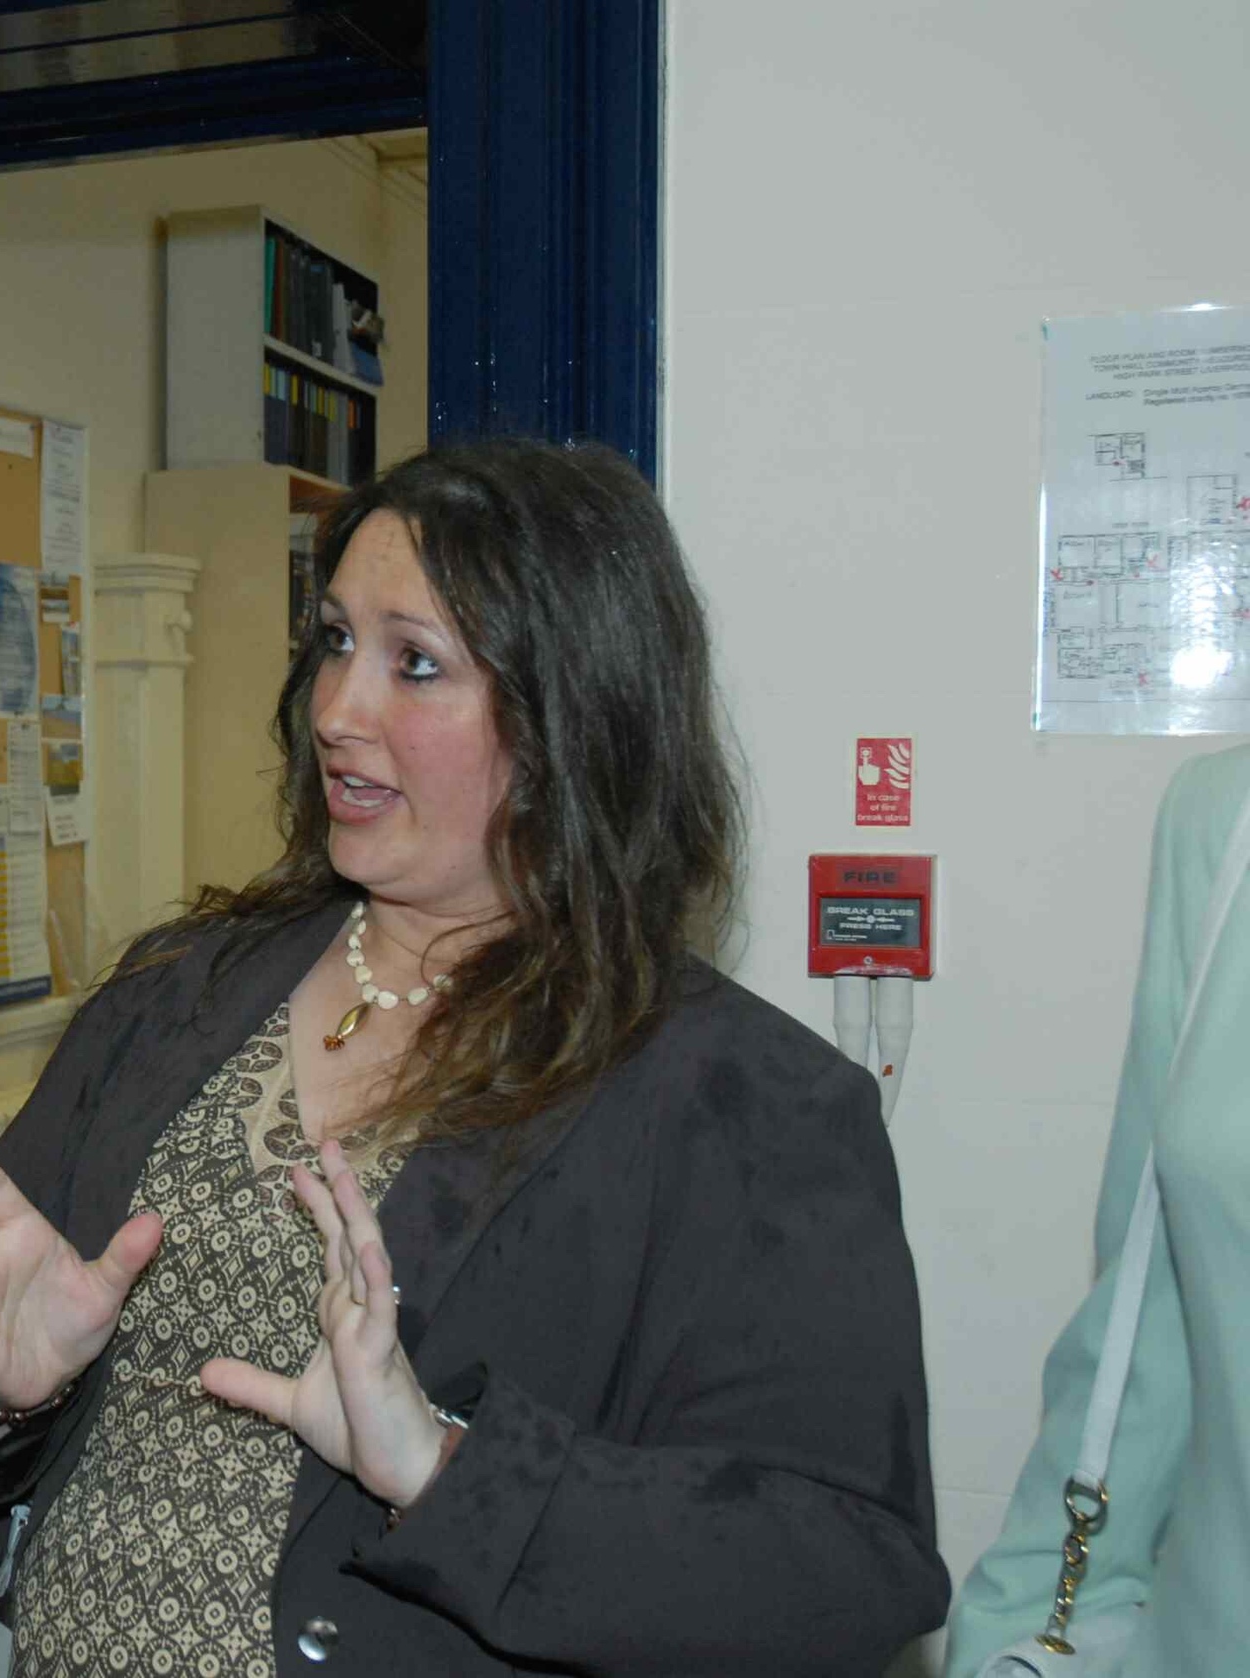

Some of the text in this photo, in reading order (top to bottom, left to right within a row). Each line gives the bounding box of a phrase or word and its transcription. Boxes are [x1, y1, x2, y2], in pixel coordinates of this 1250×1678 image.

[844, 870, 896, 883] FIRE
[826, 905, 916, 918] BREAK GLASS
[838, 921, 903, 932] PRESS HERE
